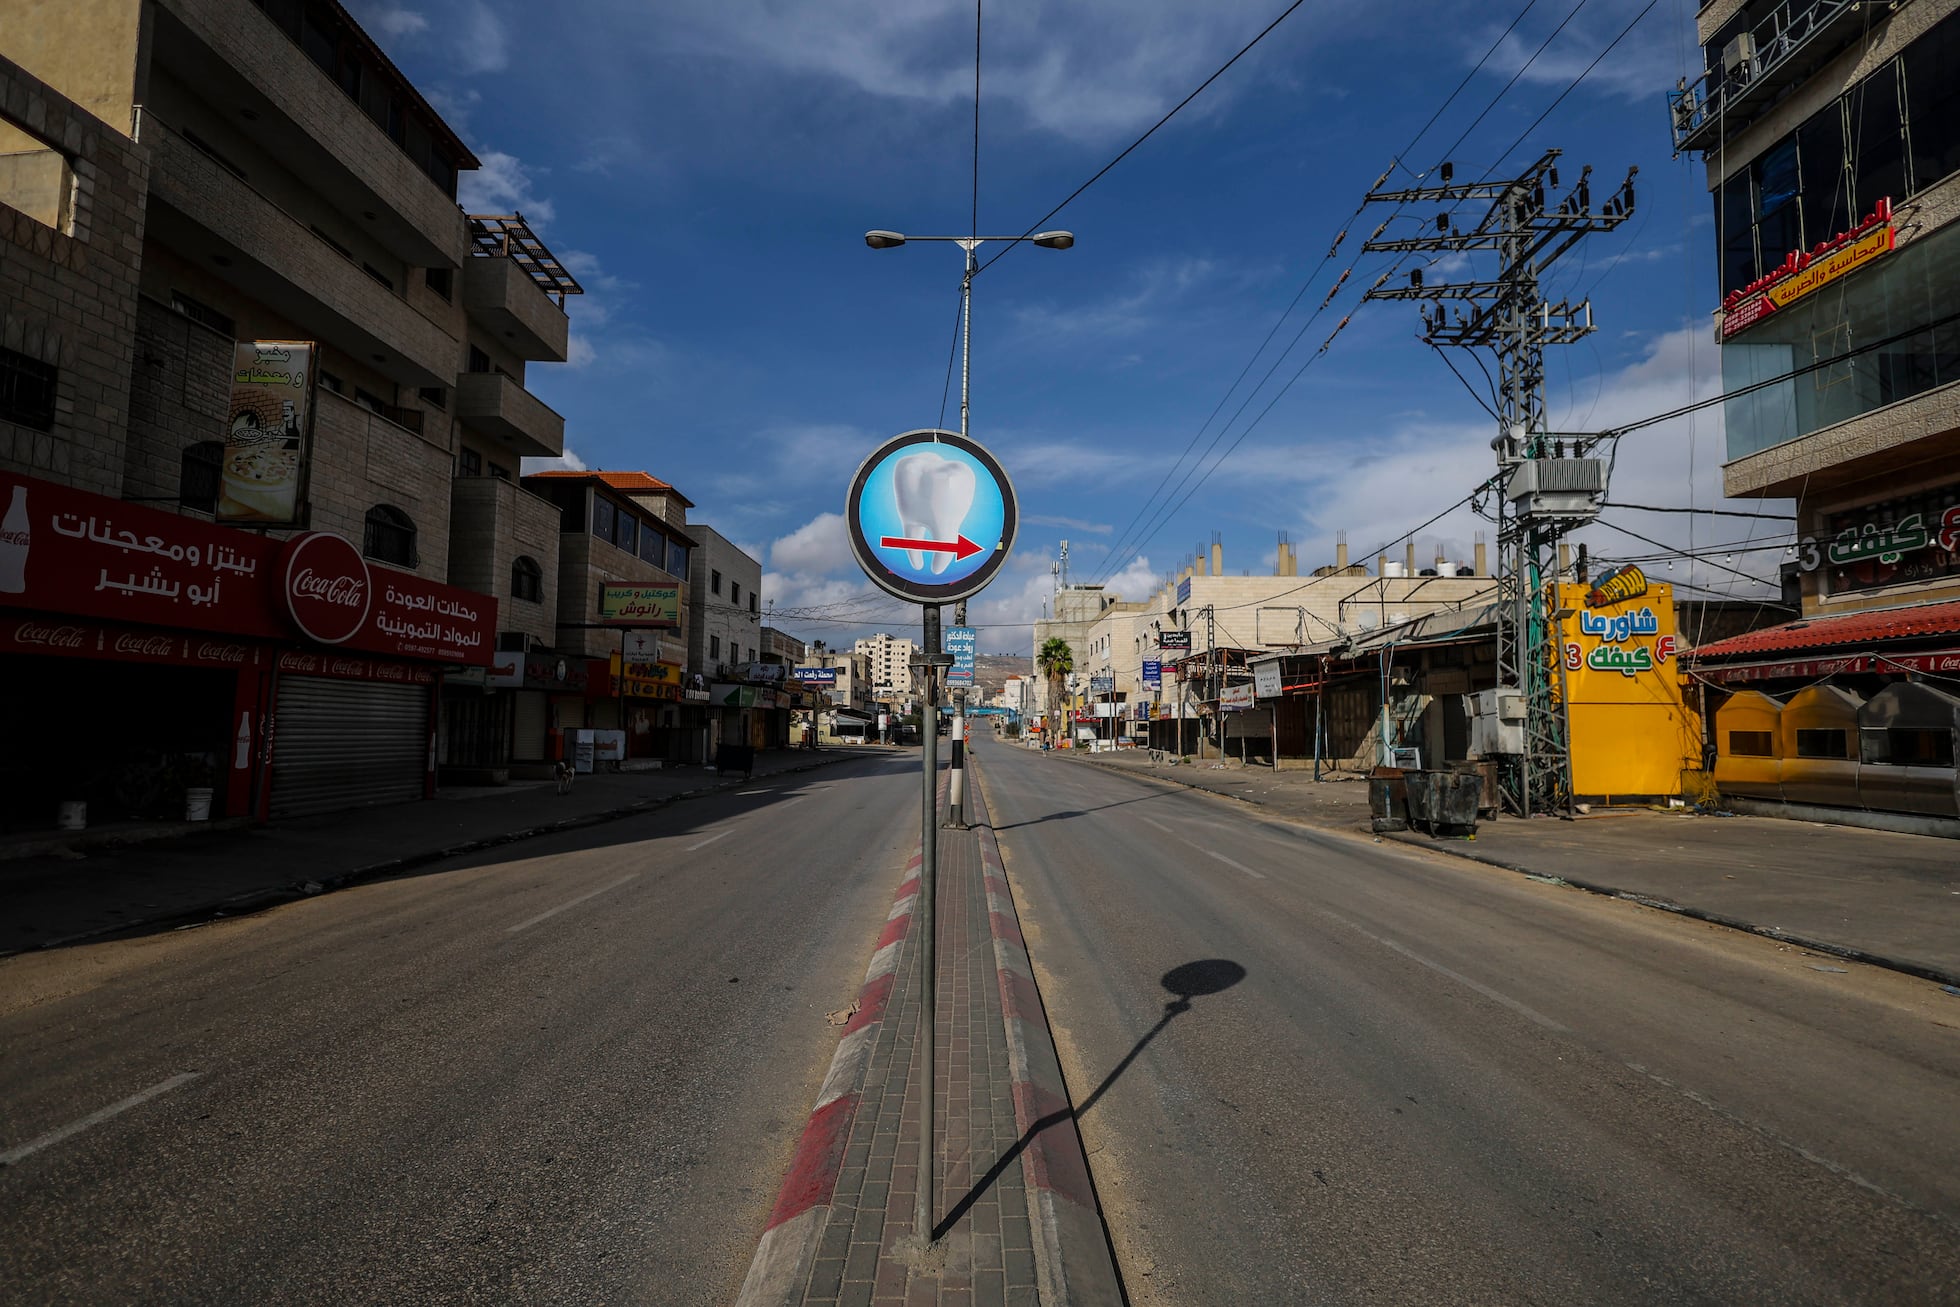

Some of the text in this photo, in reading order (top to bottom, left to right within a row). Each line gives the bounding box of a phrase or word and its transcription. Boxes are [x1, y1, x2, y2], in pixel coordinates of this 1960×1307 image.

[1829, 234, 1885, 274] للمحاسبة
[253, 346, 291, 365] مخبز
[235, 368, 291, 387] معجنات
[52, 513, 256, 578] بيتزا ومعجنات
[1800, 536, 1821, 571] 3
[1828, 512, 1928, 565] كيفك
[94, 566, 221, 607] أبو بشير
[293, 568, 364, 607] Coca-Cola
[386, 585, 477, 622] محلات العودة
[607, 589, 633, 598] كريب
[641, 590, 677, 599] كوكتيل
[620, 601, 662, 617] رانوش
[1581, 608, 1658, 642] شاورما
[376, 610, 481, 647] للمواد التموينية
[963, 631, 975, 642] عيادة
[1566, 642, 1583, 671] 3
[1587, 646, 1653, 678] كيفك
